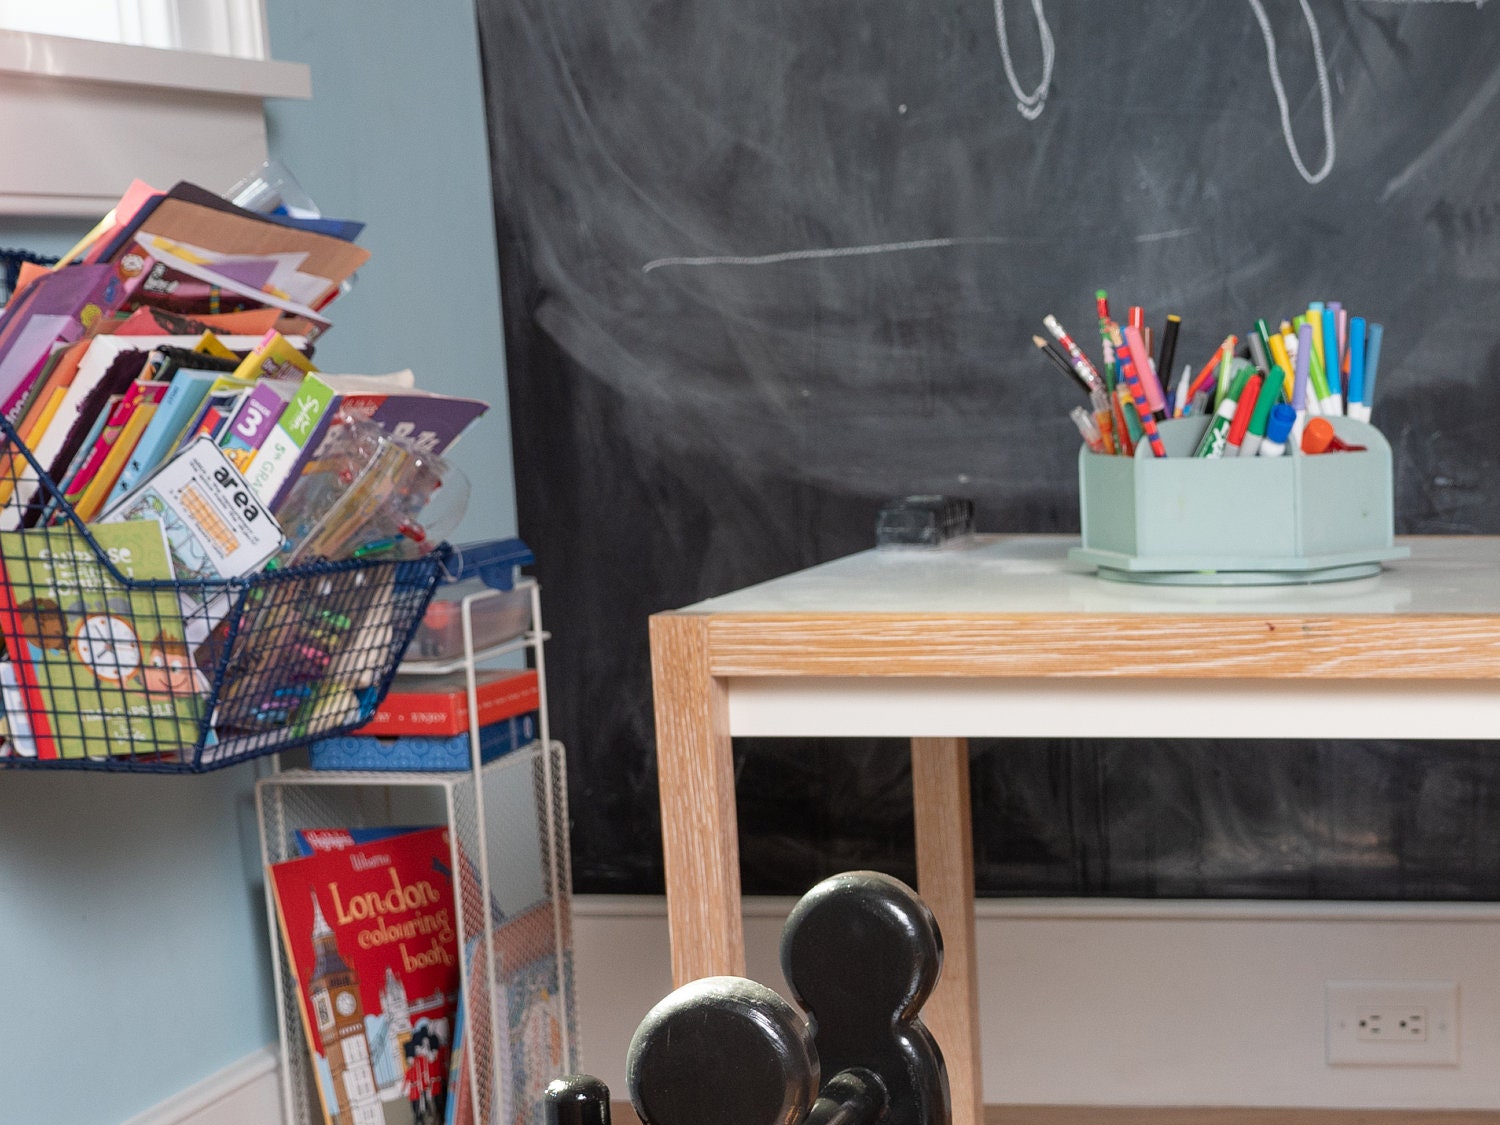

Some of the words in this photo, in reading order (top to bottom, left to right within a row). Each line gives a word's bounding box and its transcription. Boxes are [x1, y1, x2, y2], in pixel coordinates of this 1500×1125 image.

[214, 466, 259, 522] area
[328, 867, 440, 926] London
[358, 908, 455, 950] colouring
[399, 938, 455, 973] book
